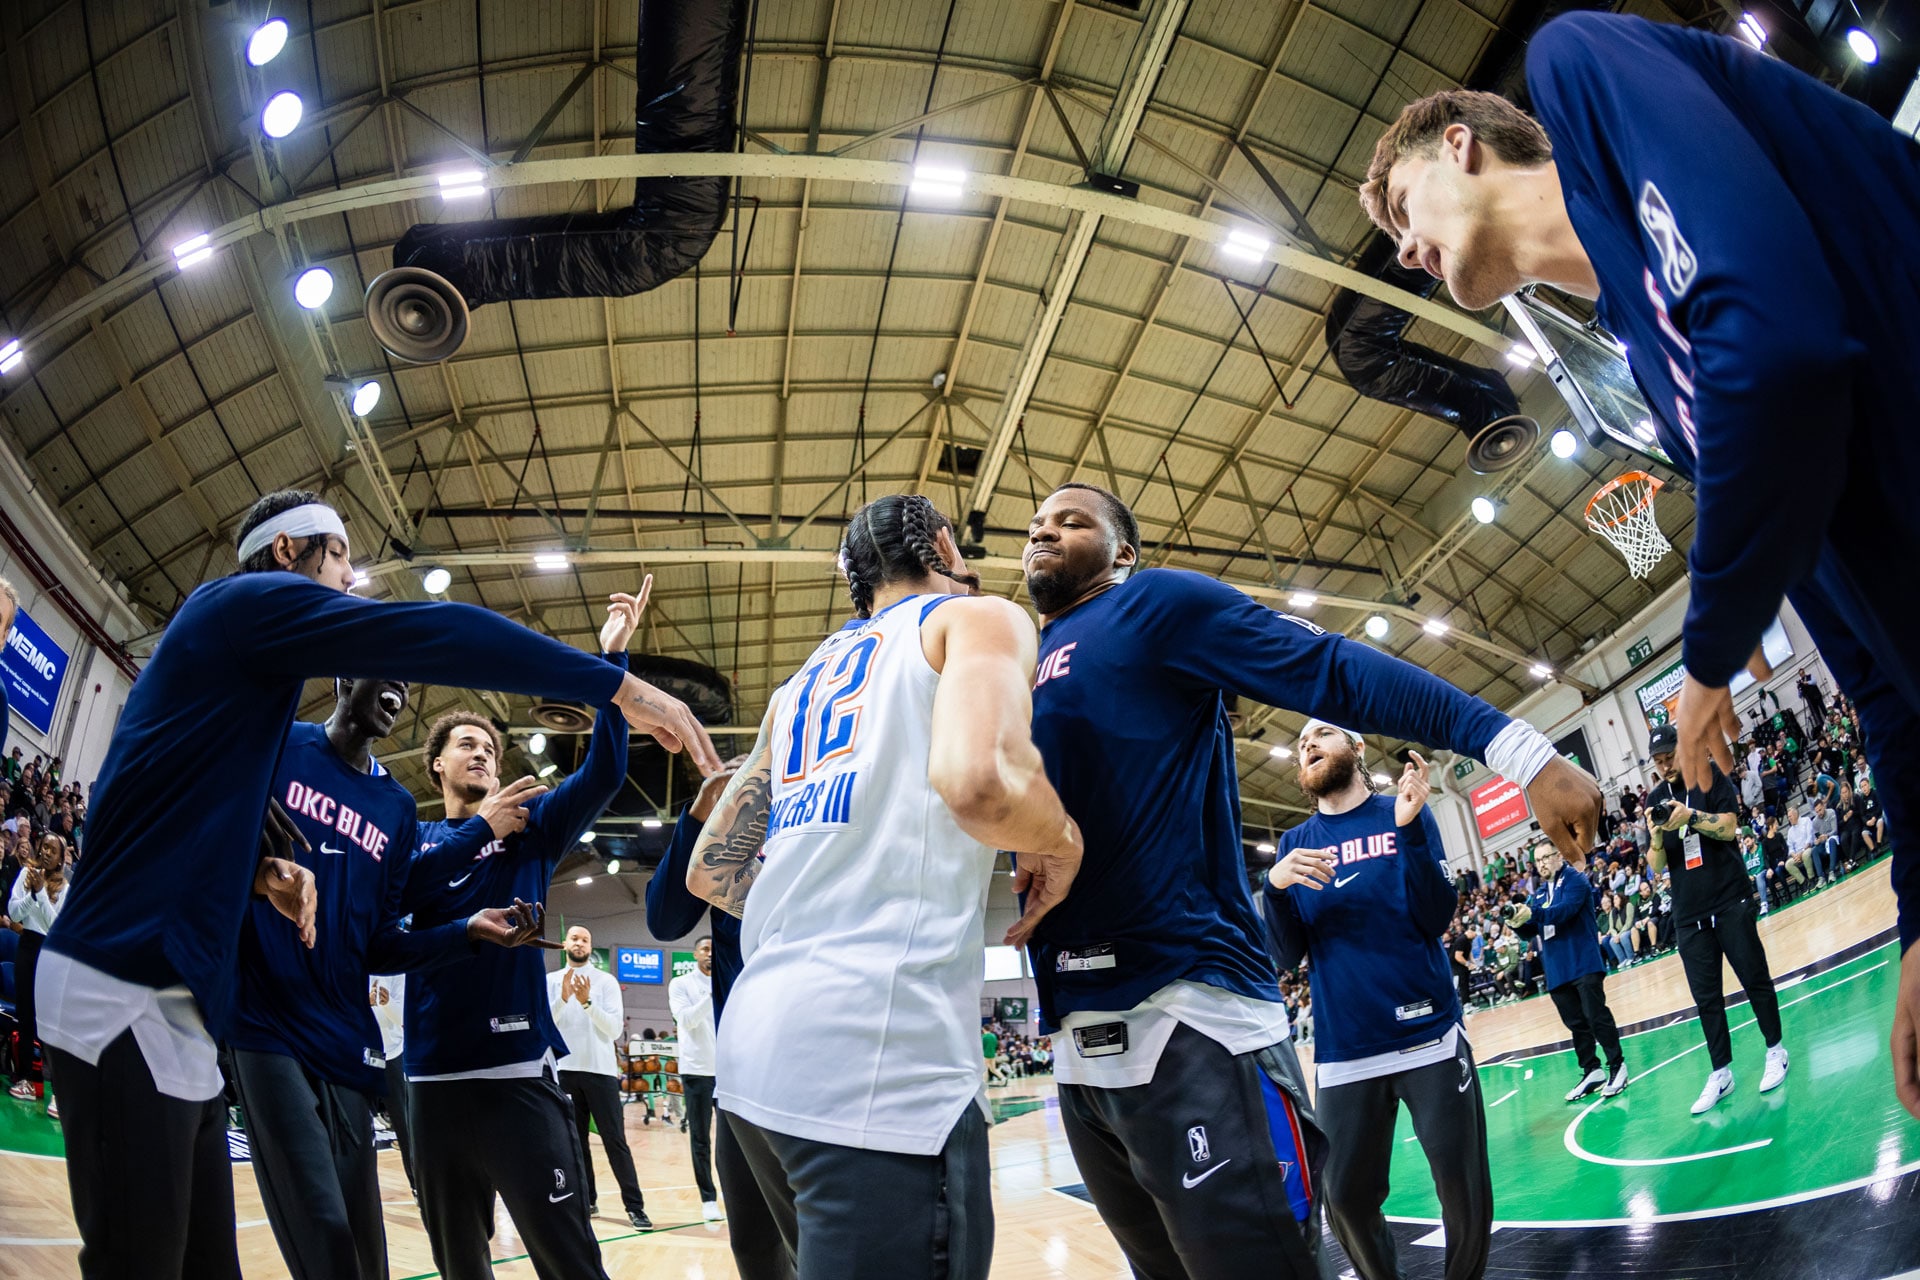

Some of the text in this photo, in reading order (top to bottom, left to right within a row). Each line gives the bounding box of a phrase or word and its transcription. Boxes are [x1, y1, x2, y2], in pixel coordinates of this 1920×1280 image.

[7, 625, 56, 681] MEMIC
[1031, 641, 1078, 692] UE
[1638, 644, 1652, 659] 12
[1638, 664, 1687, 700] Hammon
[1666, 680, 1684, 694] Comp
[782, 632, 884, 784] 12
[821, 771, 858, 824] III
[285, 780, 390, 863] OKC BLUE
[473, 839, 506, 861] UE
[1341, 831, 1397, 866] BLUE
